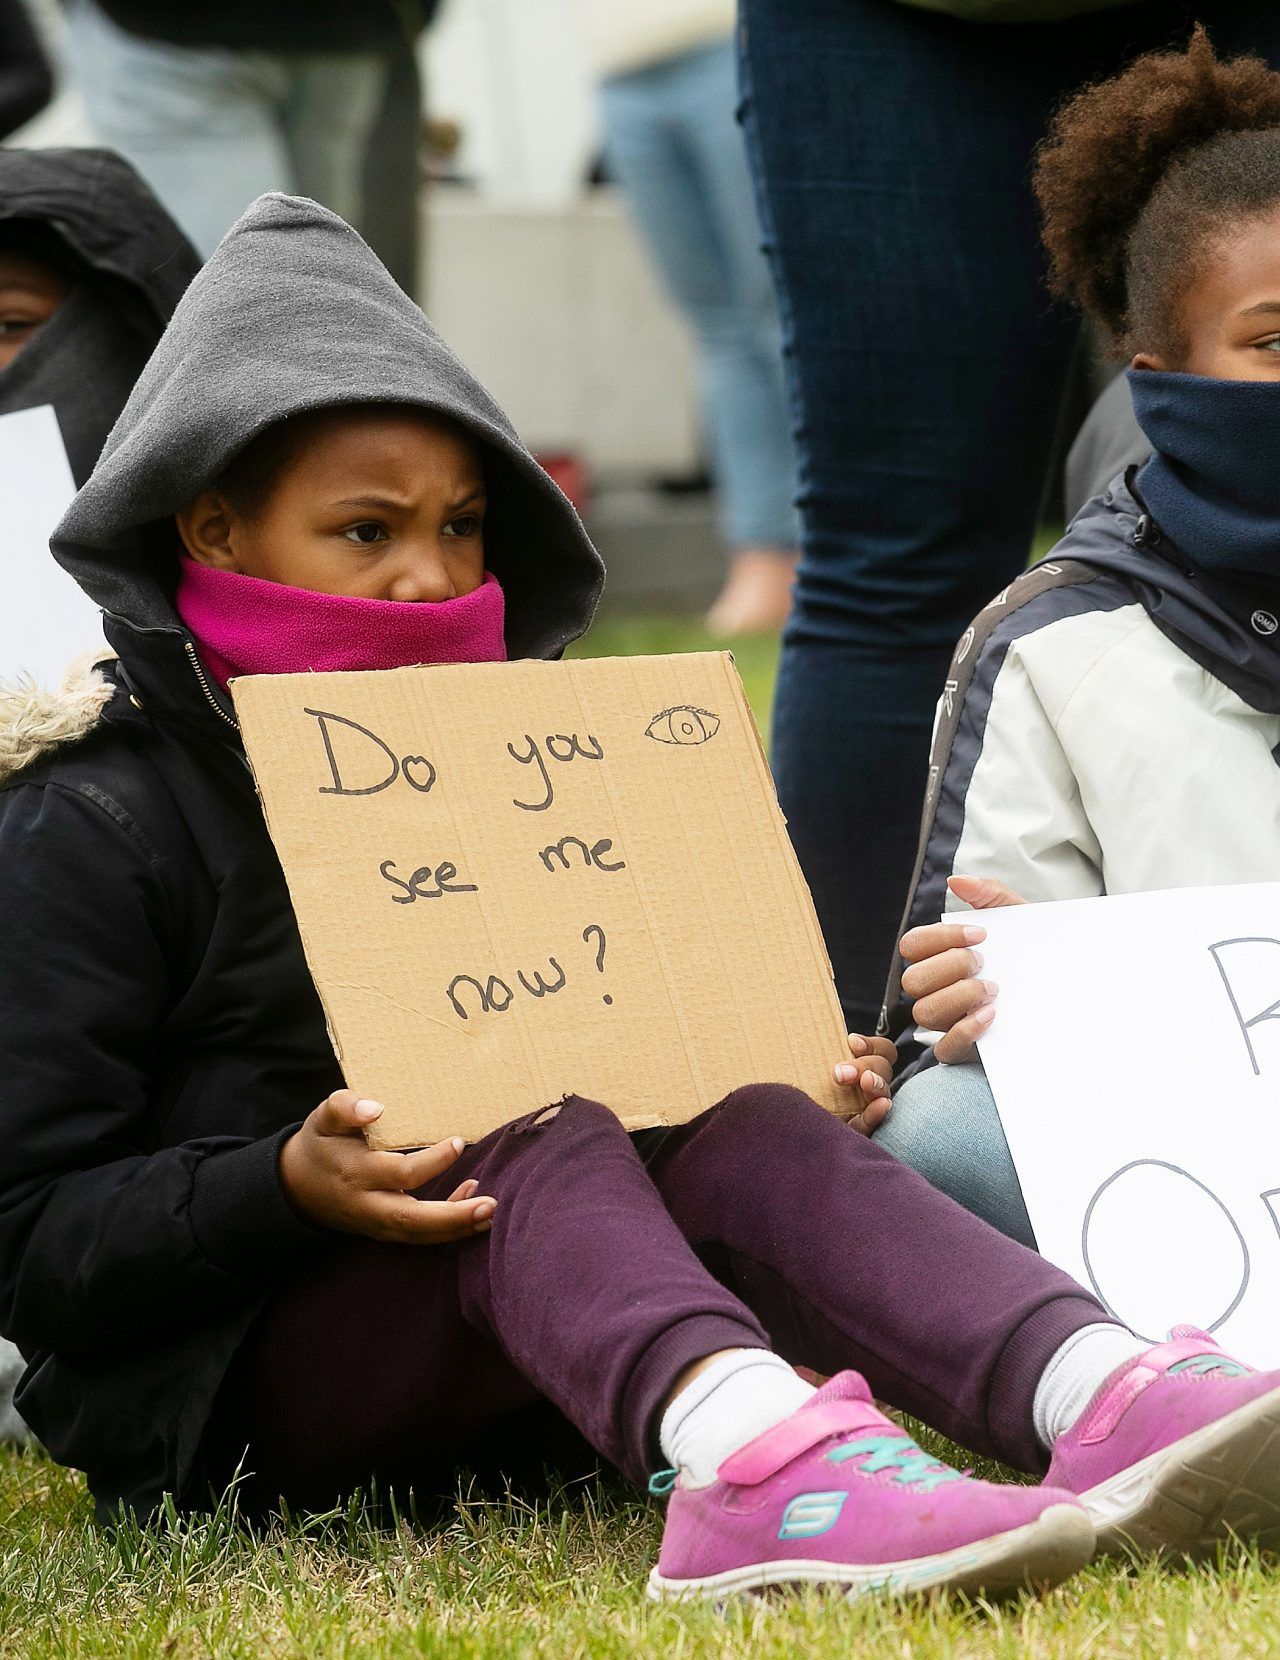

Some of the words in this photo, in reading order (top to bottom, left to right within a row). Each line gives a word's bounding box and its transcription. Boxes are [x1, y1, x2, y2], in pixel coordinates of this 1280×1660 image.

[303, 707, 436, 796] Do
[508, 733, 604, 812] you
[380, 861, 479, 904] see
[538, 836, 626, 872] me
